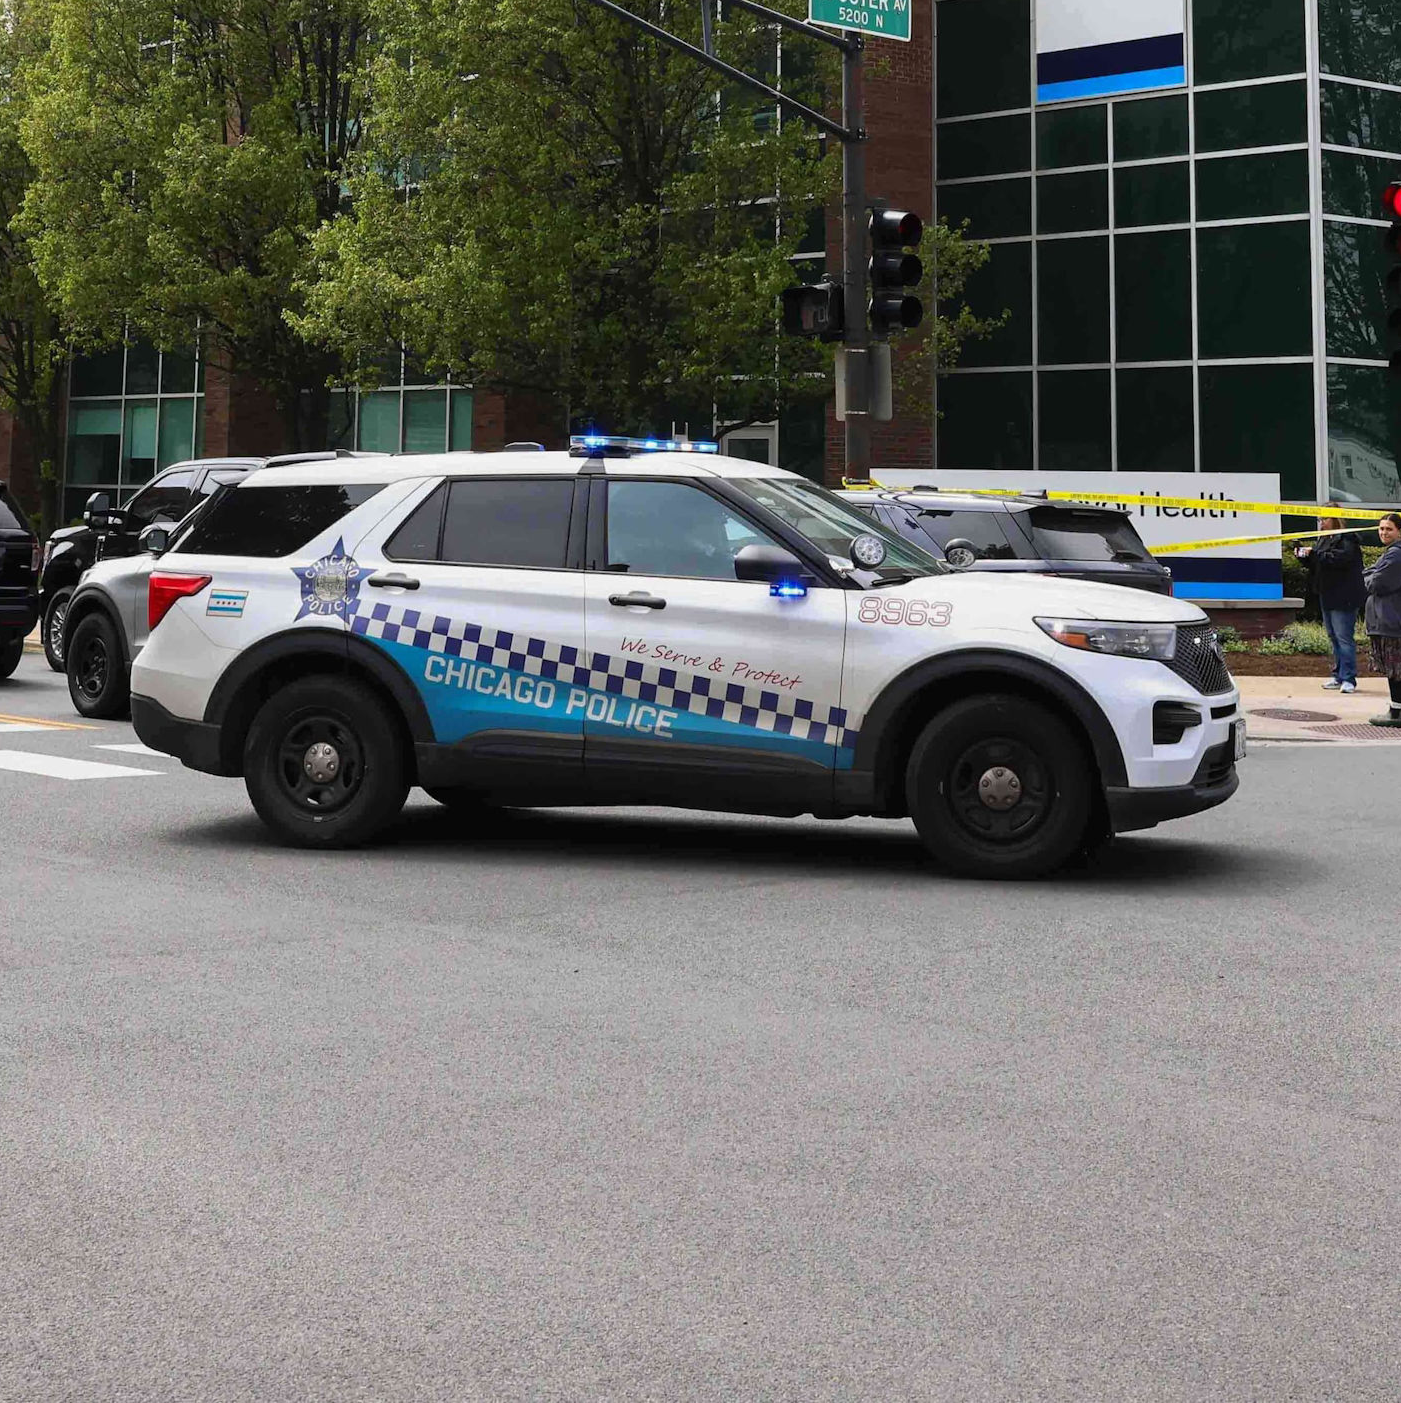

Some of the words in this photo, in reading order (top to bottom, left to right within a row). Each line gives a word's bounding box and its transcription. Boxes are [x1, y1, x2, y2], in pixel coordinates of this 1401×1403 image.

[839, 7, 868, 25] 5200
[875, 15, 883, 28] N
[305, 555, 359, 579] CHICAGO
[303, 594, 353, 614] POLICE
[858, 596, 953, 627] 8963
[620, 636, 649, 654] We
[655, 643, 705, 667] Serve
[708, 658, 725, 673] &
[732, 662, 804, 689] Protect
[423, 654, 557, 709] CHICAGO
[565, 690, 679, 738] POLICE
